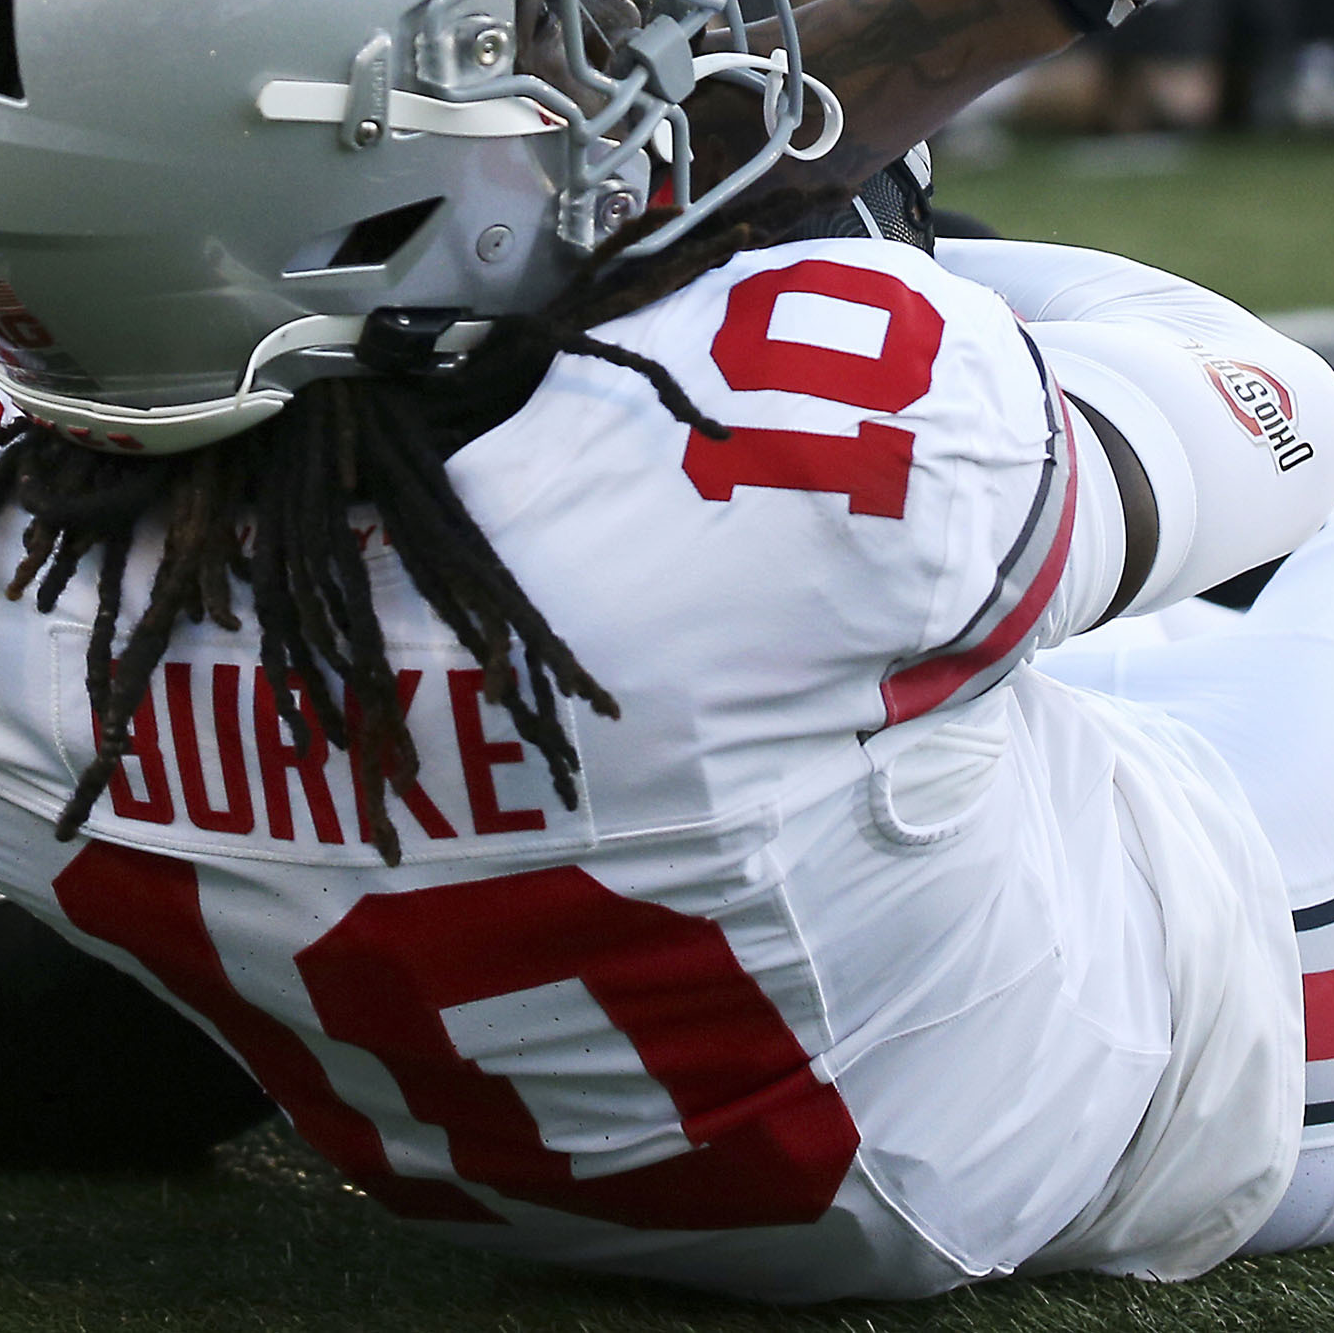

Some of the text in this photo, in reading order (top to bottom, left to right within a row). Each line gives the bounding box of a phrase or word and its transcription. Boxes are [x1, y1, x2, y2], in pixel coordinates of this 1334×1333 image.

[682, 259, 946, 521] 10
[1254, 401, 1315, 473] OHIO
[91, 662, 546, 846] BURKE
[51, 839, 862, 1232] 10
